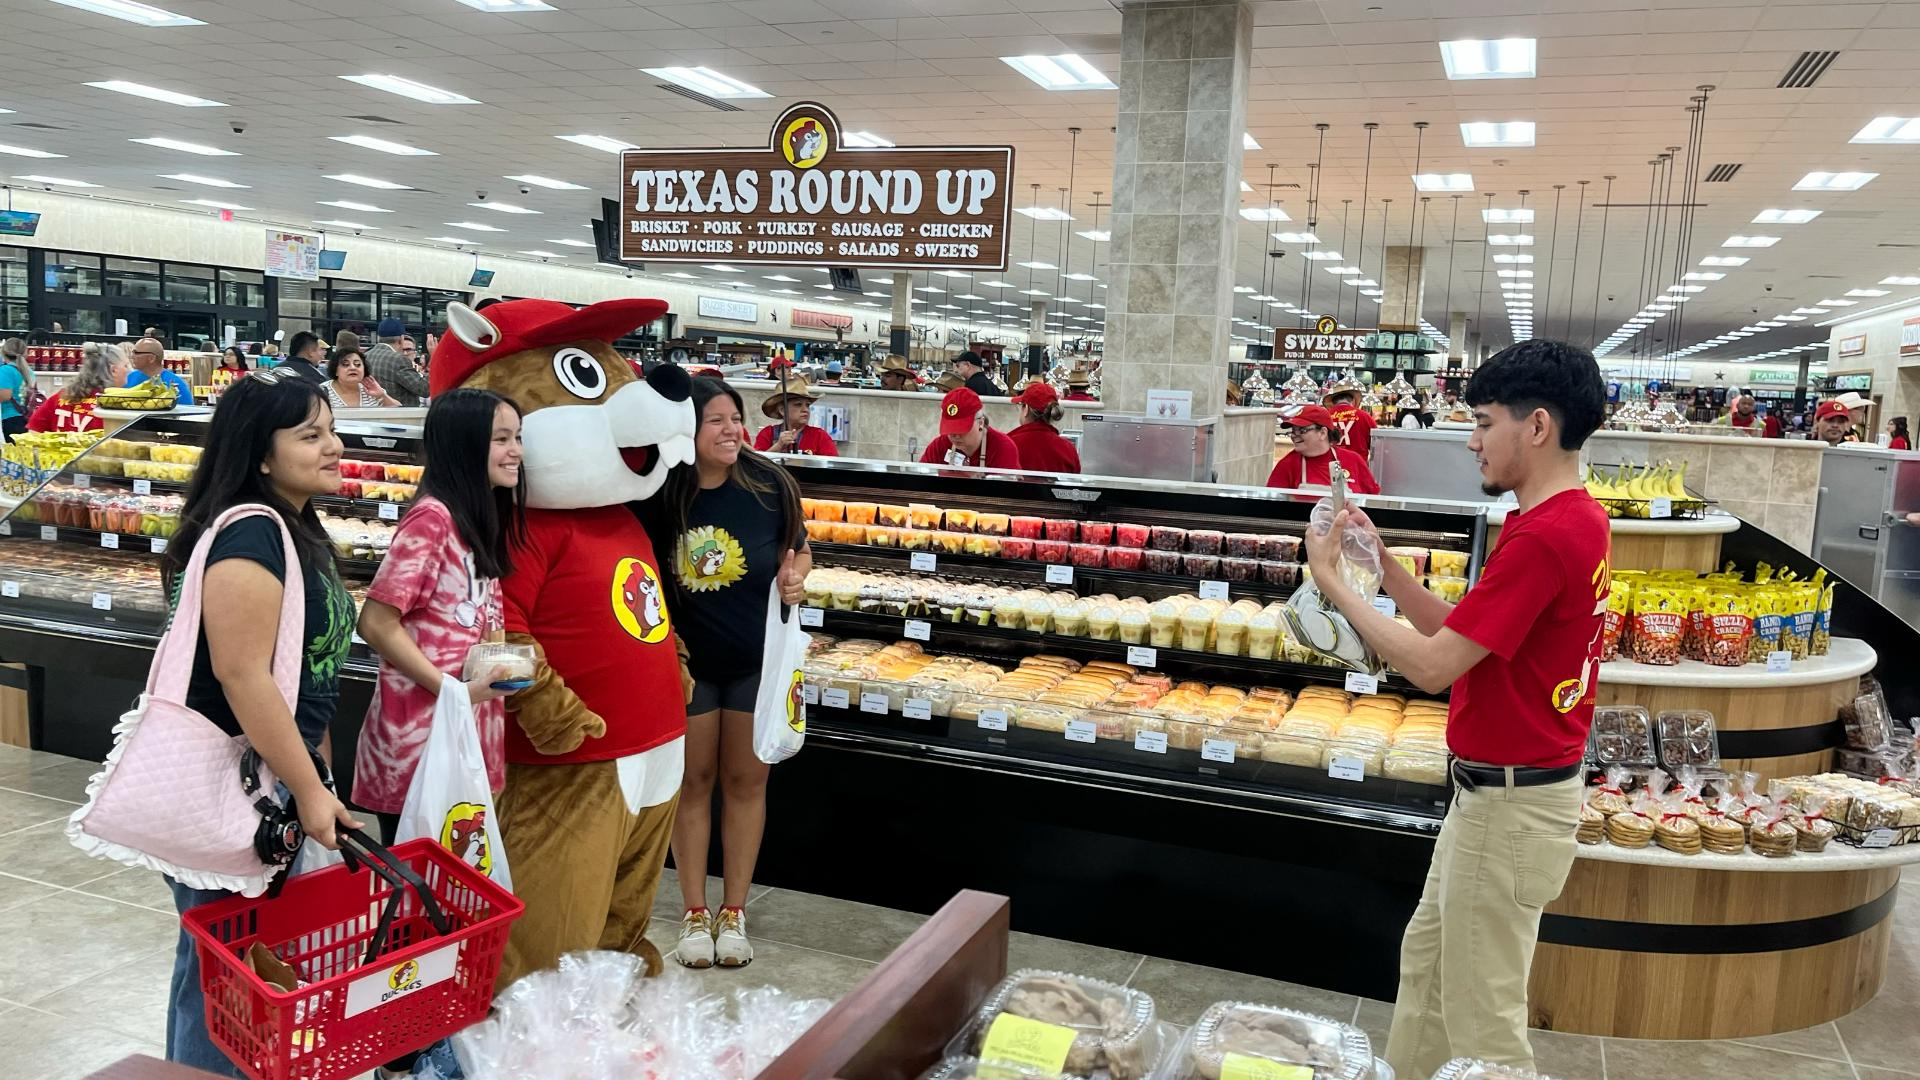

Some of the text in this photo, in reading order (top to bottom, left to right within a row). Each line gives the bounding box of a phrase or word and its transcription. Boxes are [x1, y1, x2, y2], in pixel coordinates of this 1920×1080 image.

[631, 169, 996, 216] TEXAS ROUND UP
[631, 220, 993, 238] BRISKET PORK TURKEY SAUSAGE CHICKEN
[641, 239, 979, 258] SANDWICHES PUDDINGS SALADS SWEETS
[1284, 333, 1366, 351] SWEETS
